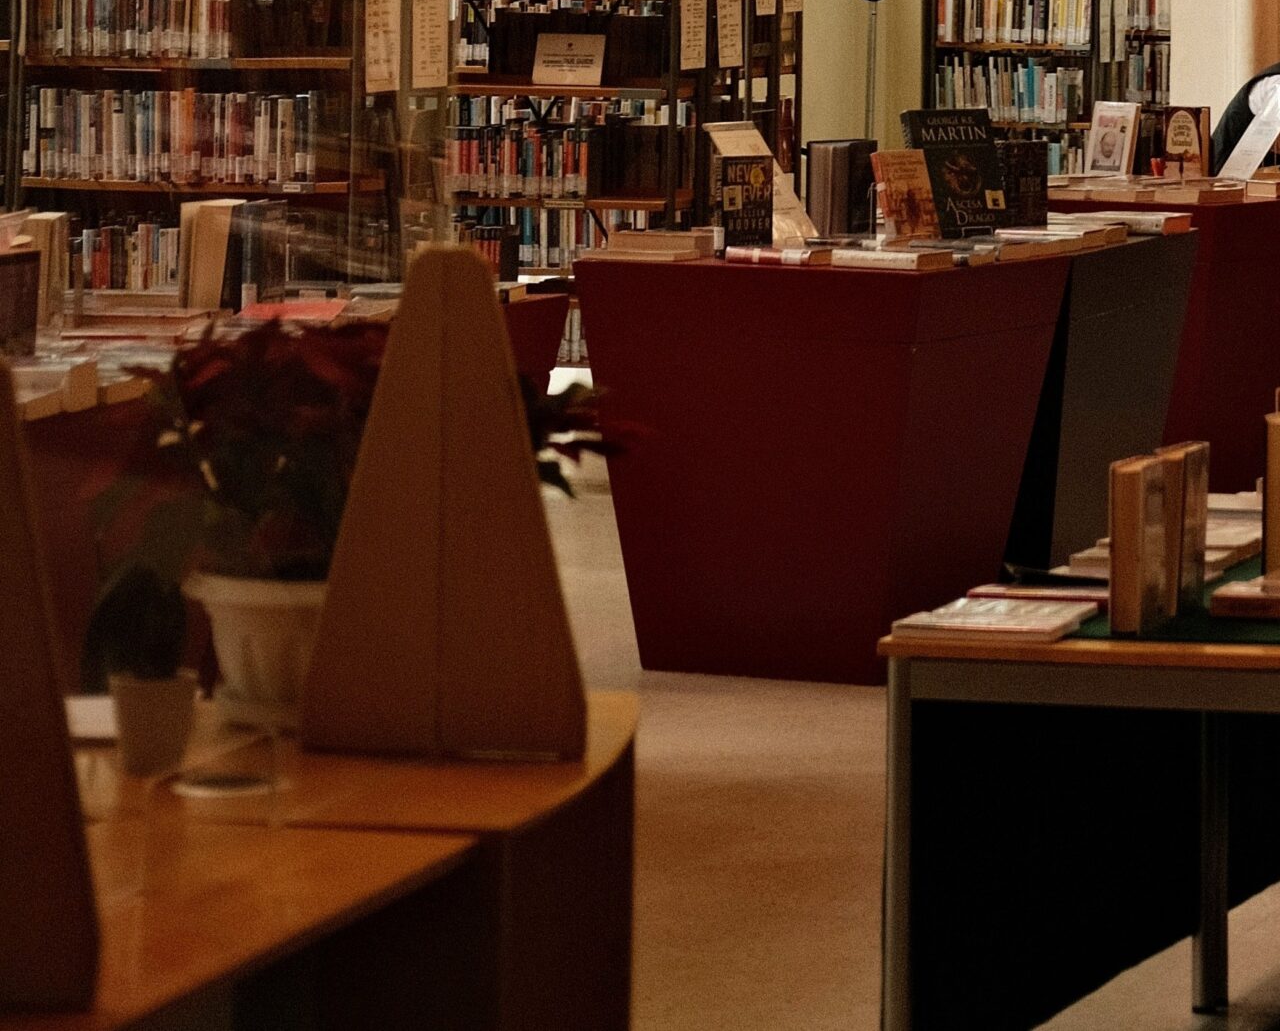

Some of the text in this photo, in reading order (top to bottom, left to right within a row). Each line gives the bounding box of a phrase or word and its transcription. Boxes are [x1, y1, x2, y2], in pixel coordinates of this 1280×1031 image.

[921, 126, 987, 142] MARTIN
[727, 163, 766, 183] NEV
[742, 185, 772, 203] EVER
